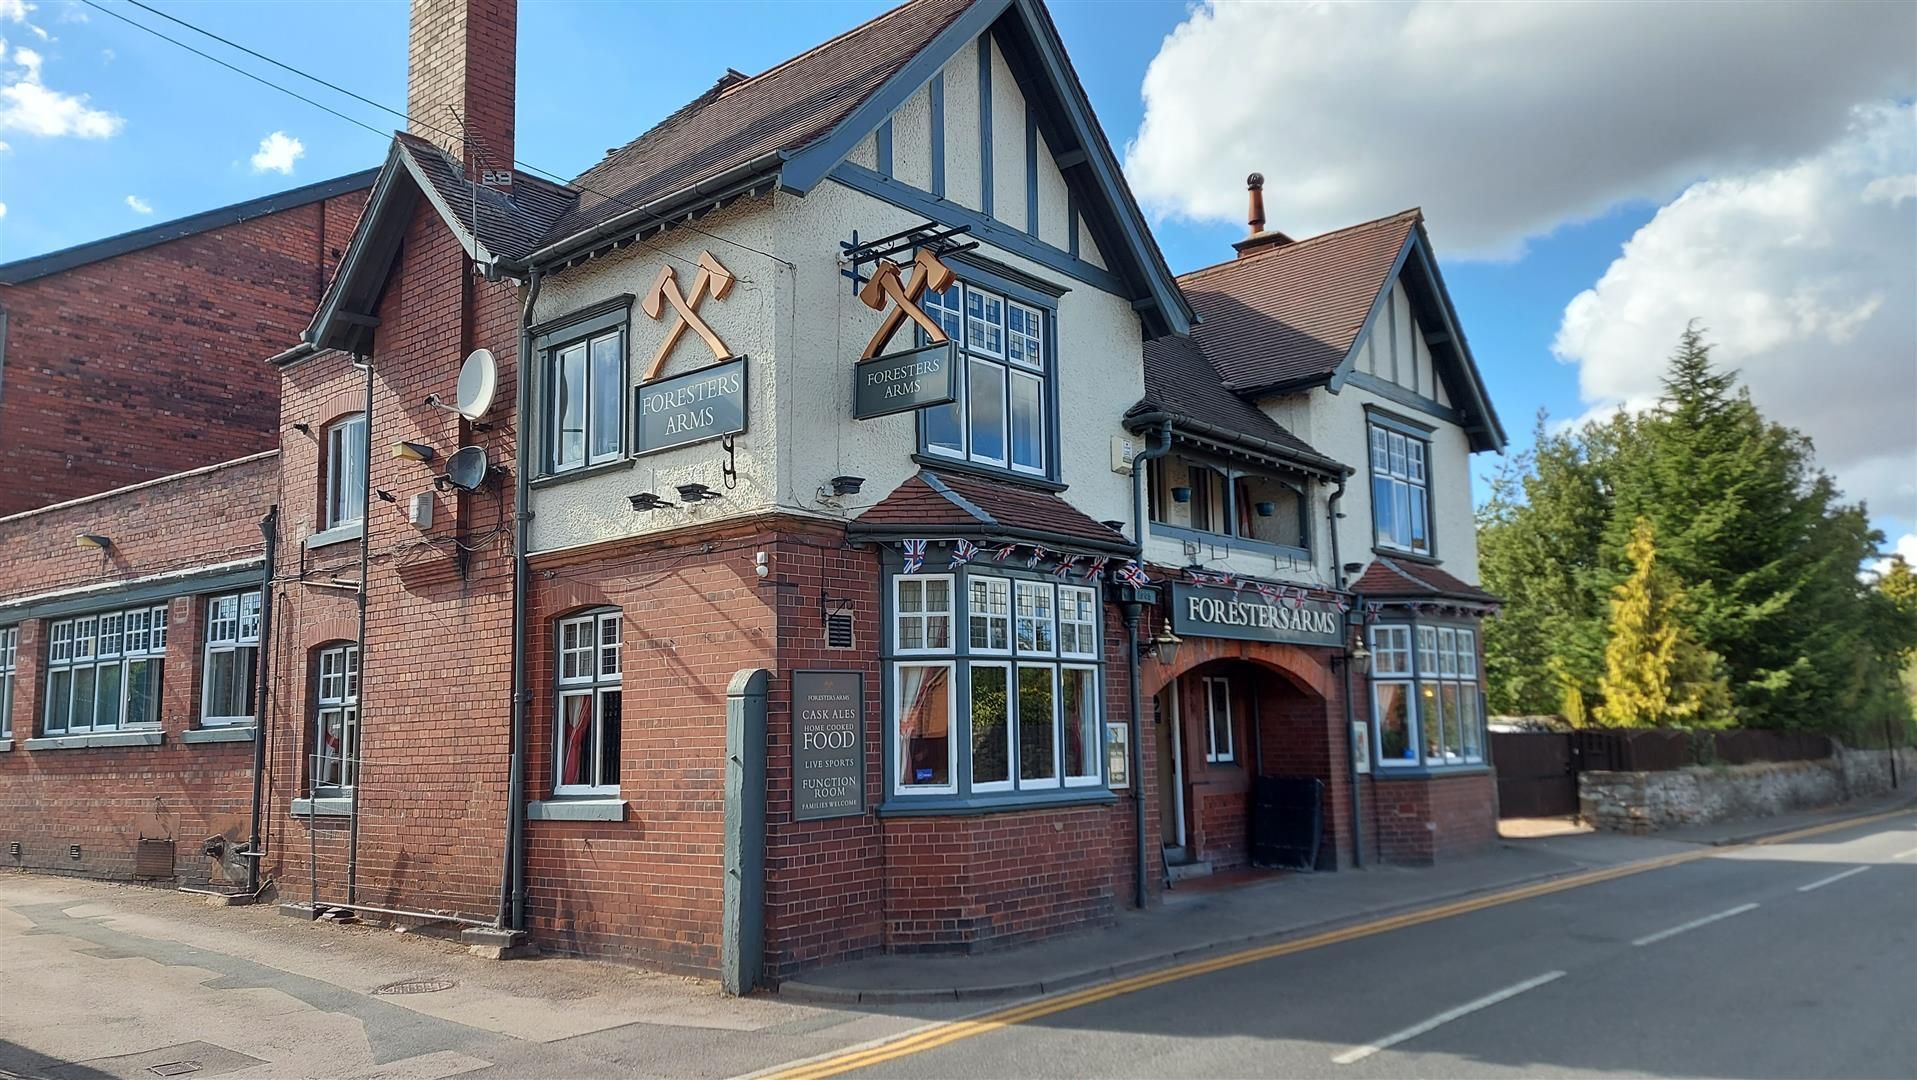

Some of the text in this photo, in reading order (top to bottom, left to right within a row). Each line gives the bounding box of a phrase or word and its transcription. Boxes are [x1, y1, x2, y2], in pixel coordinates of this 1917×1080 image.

[868, 358, 940, 386] FORESTERS
[642, 373, 739, 415] FORESTERS
[883, 379, 921, 399] ARMS
[665, 407, 713, 435] ARMS
[802, 708, 856, 720] CASK ALES
[804, 723, 854, 732] HOME COOKED
[803, 730, 855, 750] FOOD
[805, 758, 854, 769] LIVE SPORTS
[802, 776, 857, 789] FUNCTION
[815, 787, 845, 798] ROOM
[802, 802, 828, 810] FAMILIES
